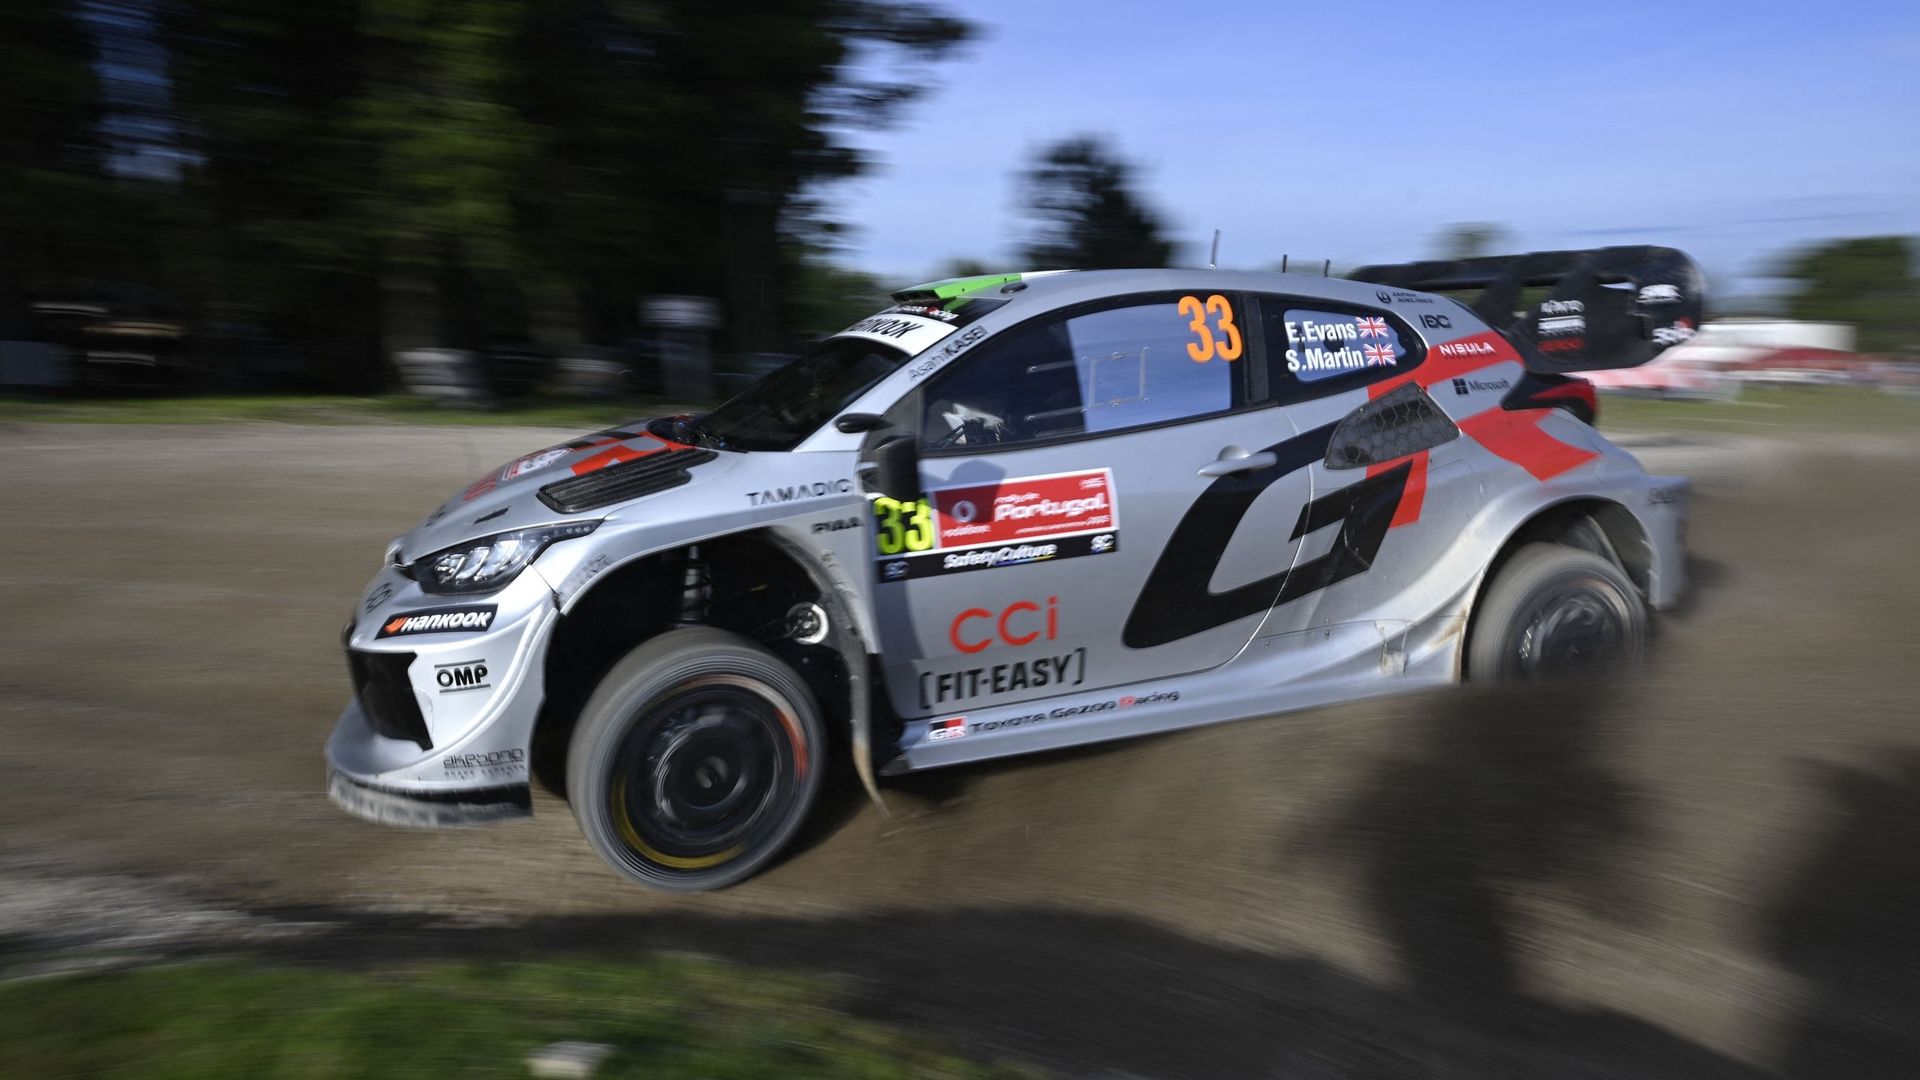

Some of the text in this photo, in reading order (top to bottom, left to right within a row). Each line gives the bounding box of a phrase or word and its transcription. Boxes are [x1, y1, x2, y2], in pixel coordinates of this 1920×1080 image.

[1178, 295, 1243, 363] 33
[1285, 319, 1357, 343] E.Evans
[1286, 347, 1365, 374] S.Martin
[1438, 340, 1496, 359] NISULA
[746, 478, 852, 508] TAMADIC
[994, 492, 1110, 523] Portugal
[874, 496, 934, 555] 33
[436, 663, 489, 688] OMP
